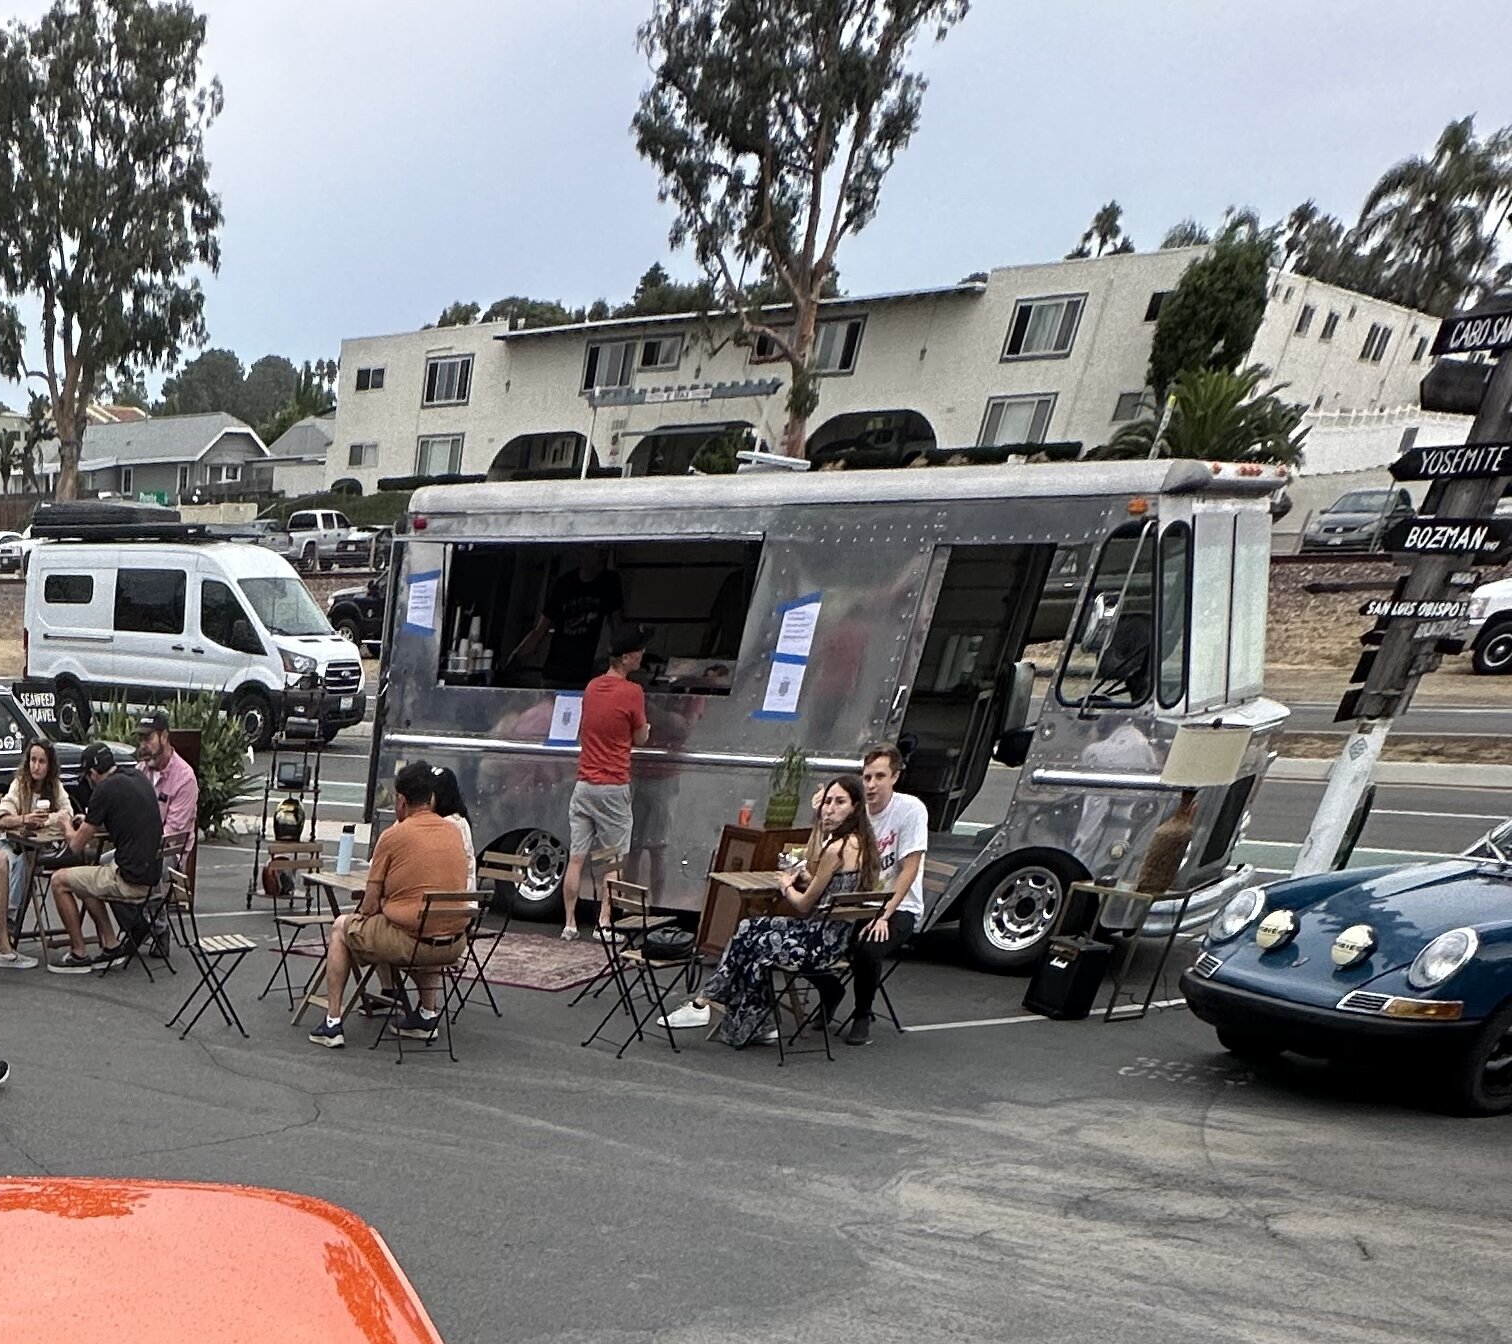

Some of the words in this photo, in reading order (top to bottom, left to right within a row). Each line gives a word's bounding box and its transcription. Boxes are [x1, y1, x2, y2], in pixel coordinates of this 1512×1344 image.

[1449, 318, 1492, 349] CABO
[1419, 446, 1510, 475] YOSEMITE
[1404, 525, 1489, 550] BOZMAN
[1366, 600, 1392, 616] SAN
[1391, 601, 1417, 616] LUIS
[1417, 602, 1460, 618] OBISPO
[20, 692, 56, 708] SEAWEED
